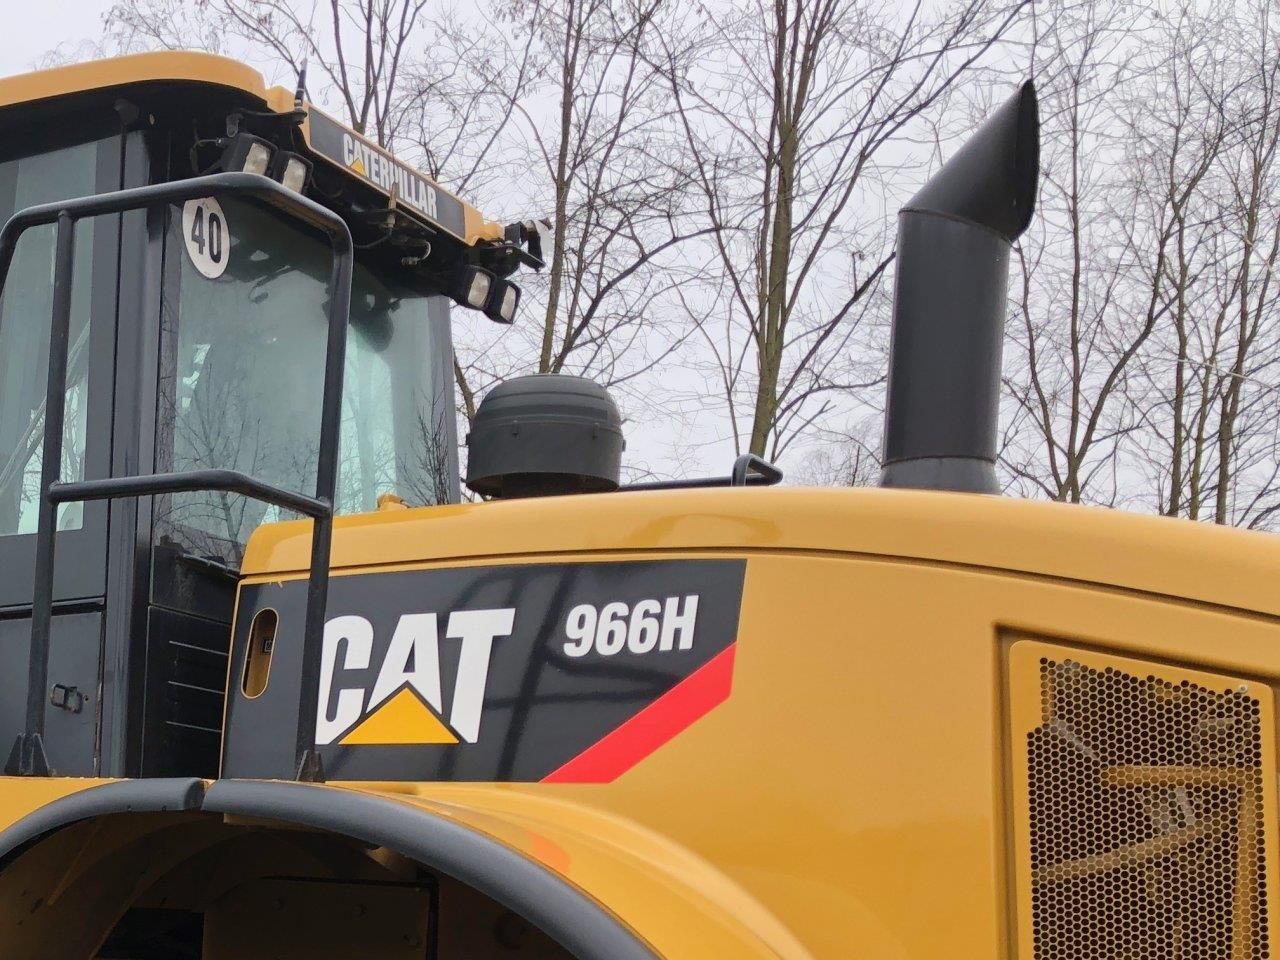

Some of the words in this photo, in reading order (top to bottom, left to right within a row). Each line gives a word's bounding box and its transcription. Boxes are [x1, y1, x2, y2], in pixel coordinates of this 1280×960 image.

[343, 133, 437, 220] CATERPILLAR
[191, 206, 222, 264] 40
[562, 595, 699, 658] 966H
[314, 608, 516, 746] CAT
